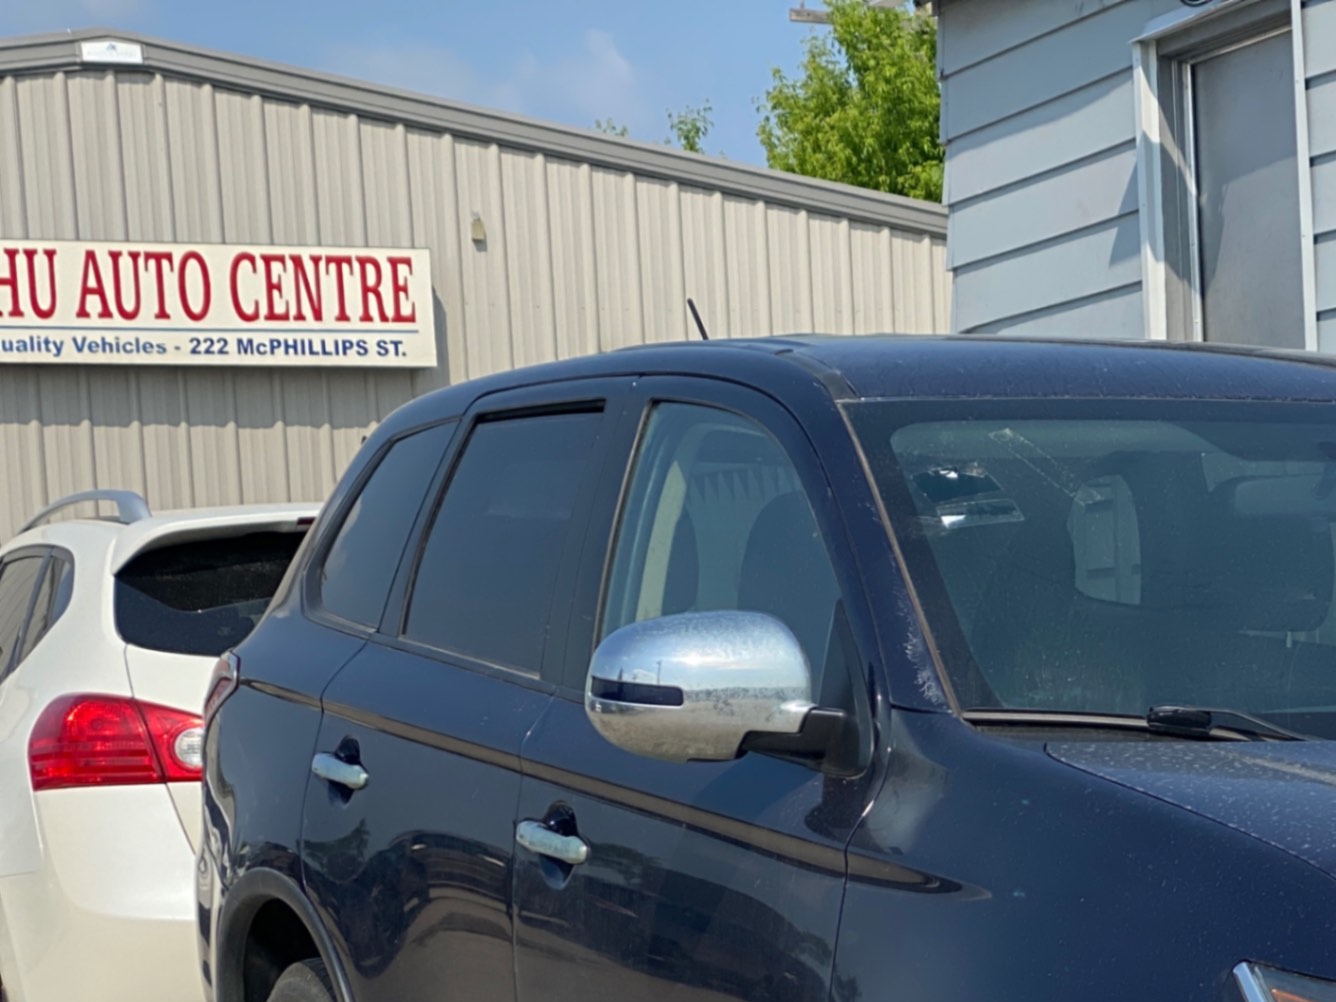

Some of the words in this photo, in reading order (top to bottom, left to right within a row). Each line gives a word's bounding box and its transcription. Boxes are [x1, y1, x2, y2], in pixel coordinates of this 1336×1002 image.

[76, 249, 211, 322] AUTO
[230, 252, 417, 324] CENTRE
[72, 336, 167, 355] Vehicles
[189, 337, 229, 355] 222
[236, 338, 369, 356] McPHILLIPS
[376, 340, 407, 357] ST.
